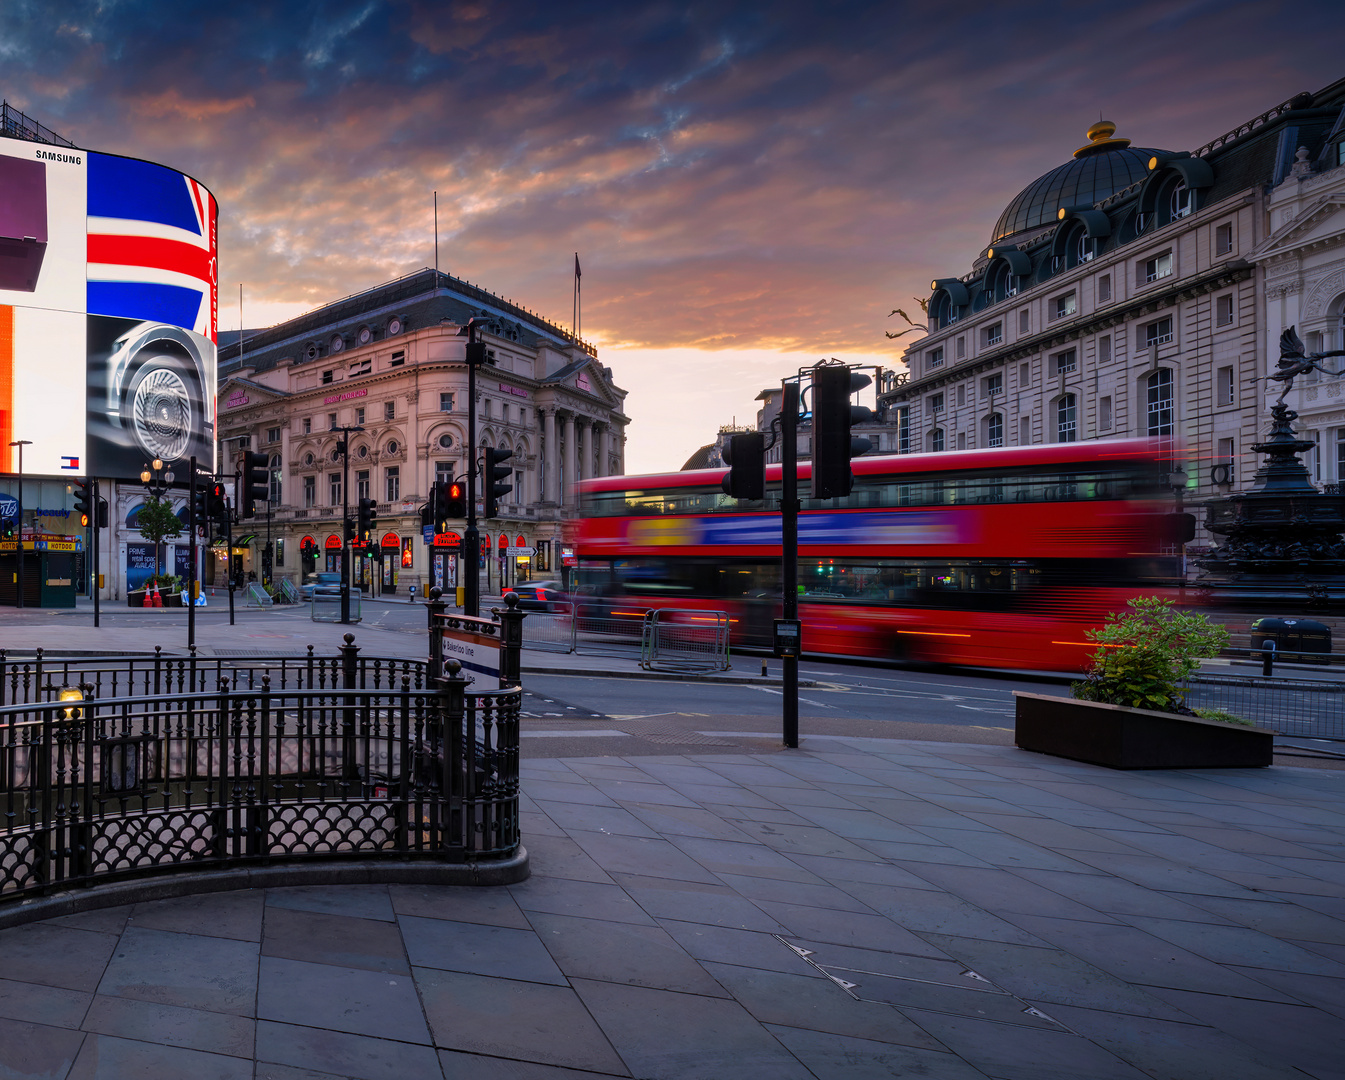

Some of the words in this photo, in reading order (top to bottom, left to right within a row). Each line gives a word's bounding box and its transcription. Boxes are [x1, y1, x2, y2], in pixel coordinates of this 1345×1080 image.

[35, 149, 82, 165] SAMSUNG
[35, 507, 71, 519] beauty
[128, 547, 146, 555] PRIME
[446, 641, 464, 654] Bakerloo
[465, 646, 475, 657] line
